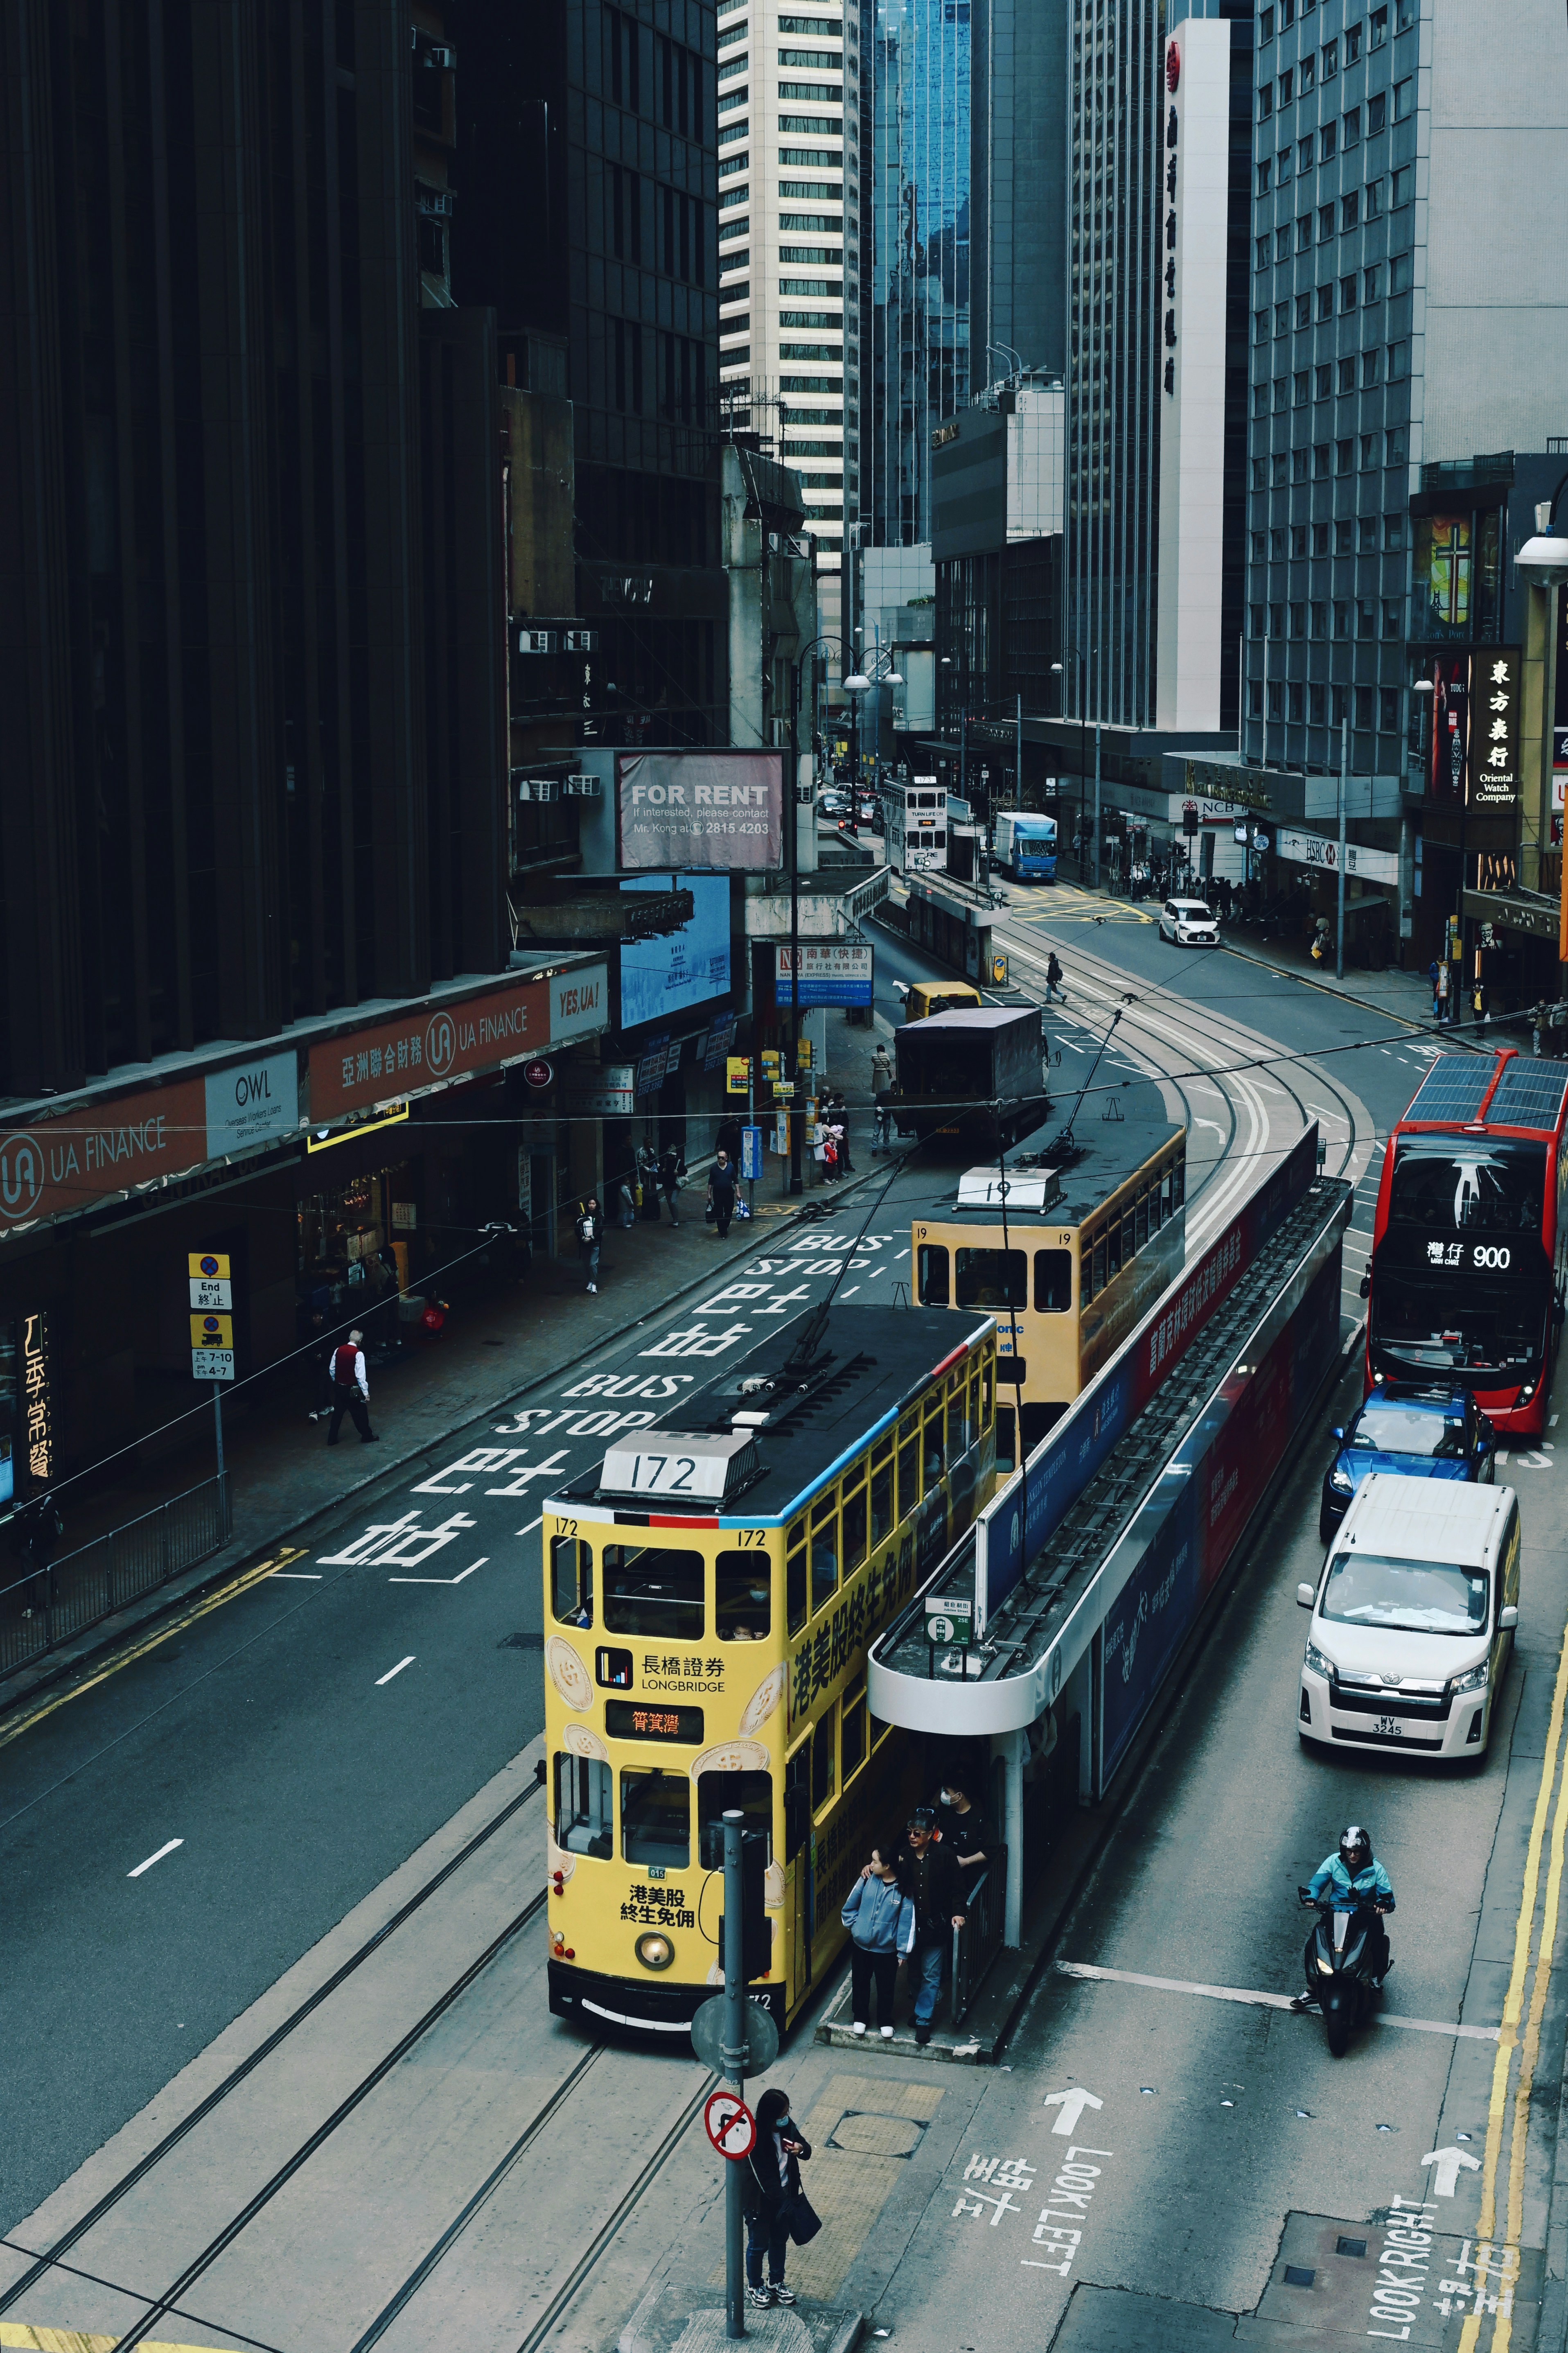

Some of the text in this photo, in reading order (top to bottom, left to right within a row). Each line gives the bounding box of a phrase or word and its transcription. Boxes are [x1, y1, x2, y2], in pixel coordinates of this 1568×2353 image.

[1488, 659, 1510, 767] 東方表行
[1479, 773, 1514, 783] Oriental
[1484, 784, 1509, 792] Watch
[632, 785, 768, 805] FOR RENT
[1475, 793, 1516, 803] Company
[634, 807, 769, 820] If interested, please contact
[1203, 802, 1234, 813] NCB
[634, 822, 769, 835] Mr. Kong at 2815 4203
[1307, 839, 1325, 863] HSBC
[807, 948, 868, 960] 南華(快捷)
[459, 1005, 527, 1051] UA FINANCE
[342, 1035, 422, 1087] 亞洲聯合財務
[236, 1070, 271, 1106] OWL
[225, 1105, 282, 1129] Overseas Workers Loans
[237, 1125, 255, 1139] Service
[50, 1125, 167, 1182] UA FINANCE
[986, 1180, 1011, 1202] 19
[789, 1235, 894, 1252] BUS
[917, 1228, 927, 1239] 19
[1058, 1233, 1071, 1245] 19
[1427, 1242, 1464, 1260] 灣仔
[1473, 1246, 1510, 1269] 900
[742, 1258, 875, 1276] STOP
[201, 1282, 220, 1291] End
[198, 1294, 224, 1306] 終止
[691, 1283, 811, 1314] 巴士
[637, 1322, 753, 1357] 站
[209, 1353, 232, 1362] 7-10
[209, 1366, 226, 1376] 4-7
[561, 1374, 694, 1399] BUS
[493, 1408, 657, 1437] STOP
[408, 1447, 572, 1497] 巴士
[630, 1454, 696, 1491] 172
[1022, 1469, 1044, 1508] FANKLIN
[555, 1517, 578, 1536] 172
[316, 1510, 477, 1567] 站
[738, 1529, 767, 1547] 172
[792, 1530, 913, 1724] 港美股終生免佣
[641, 1655, 726, 1678] 長橋證券
[642, 1678, 725, 1693] LONGBRIDGE
[632, 1710, 680, 1734] 筲箕灣
[1372, 1724, 1402, 1735] 3245
[1381, 1716, 1395, 1726] WV
[650, 1869, 664, 1878] 015
[629, 1884, 685, 1908] 港美股
[620, 1902, 695, 1928] 終生免佣
[1020, 2145, 1114, 2276] LOOK LEFT
[1365, 2194, 1439, 2340] LOOK RIGHT
